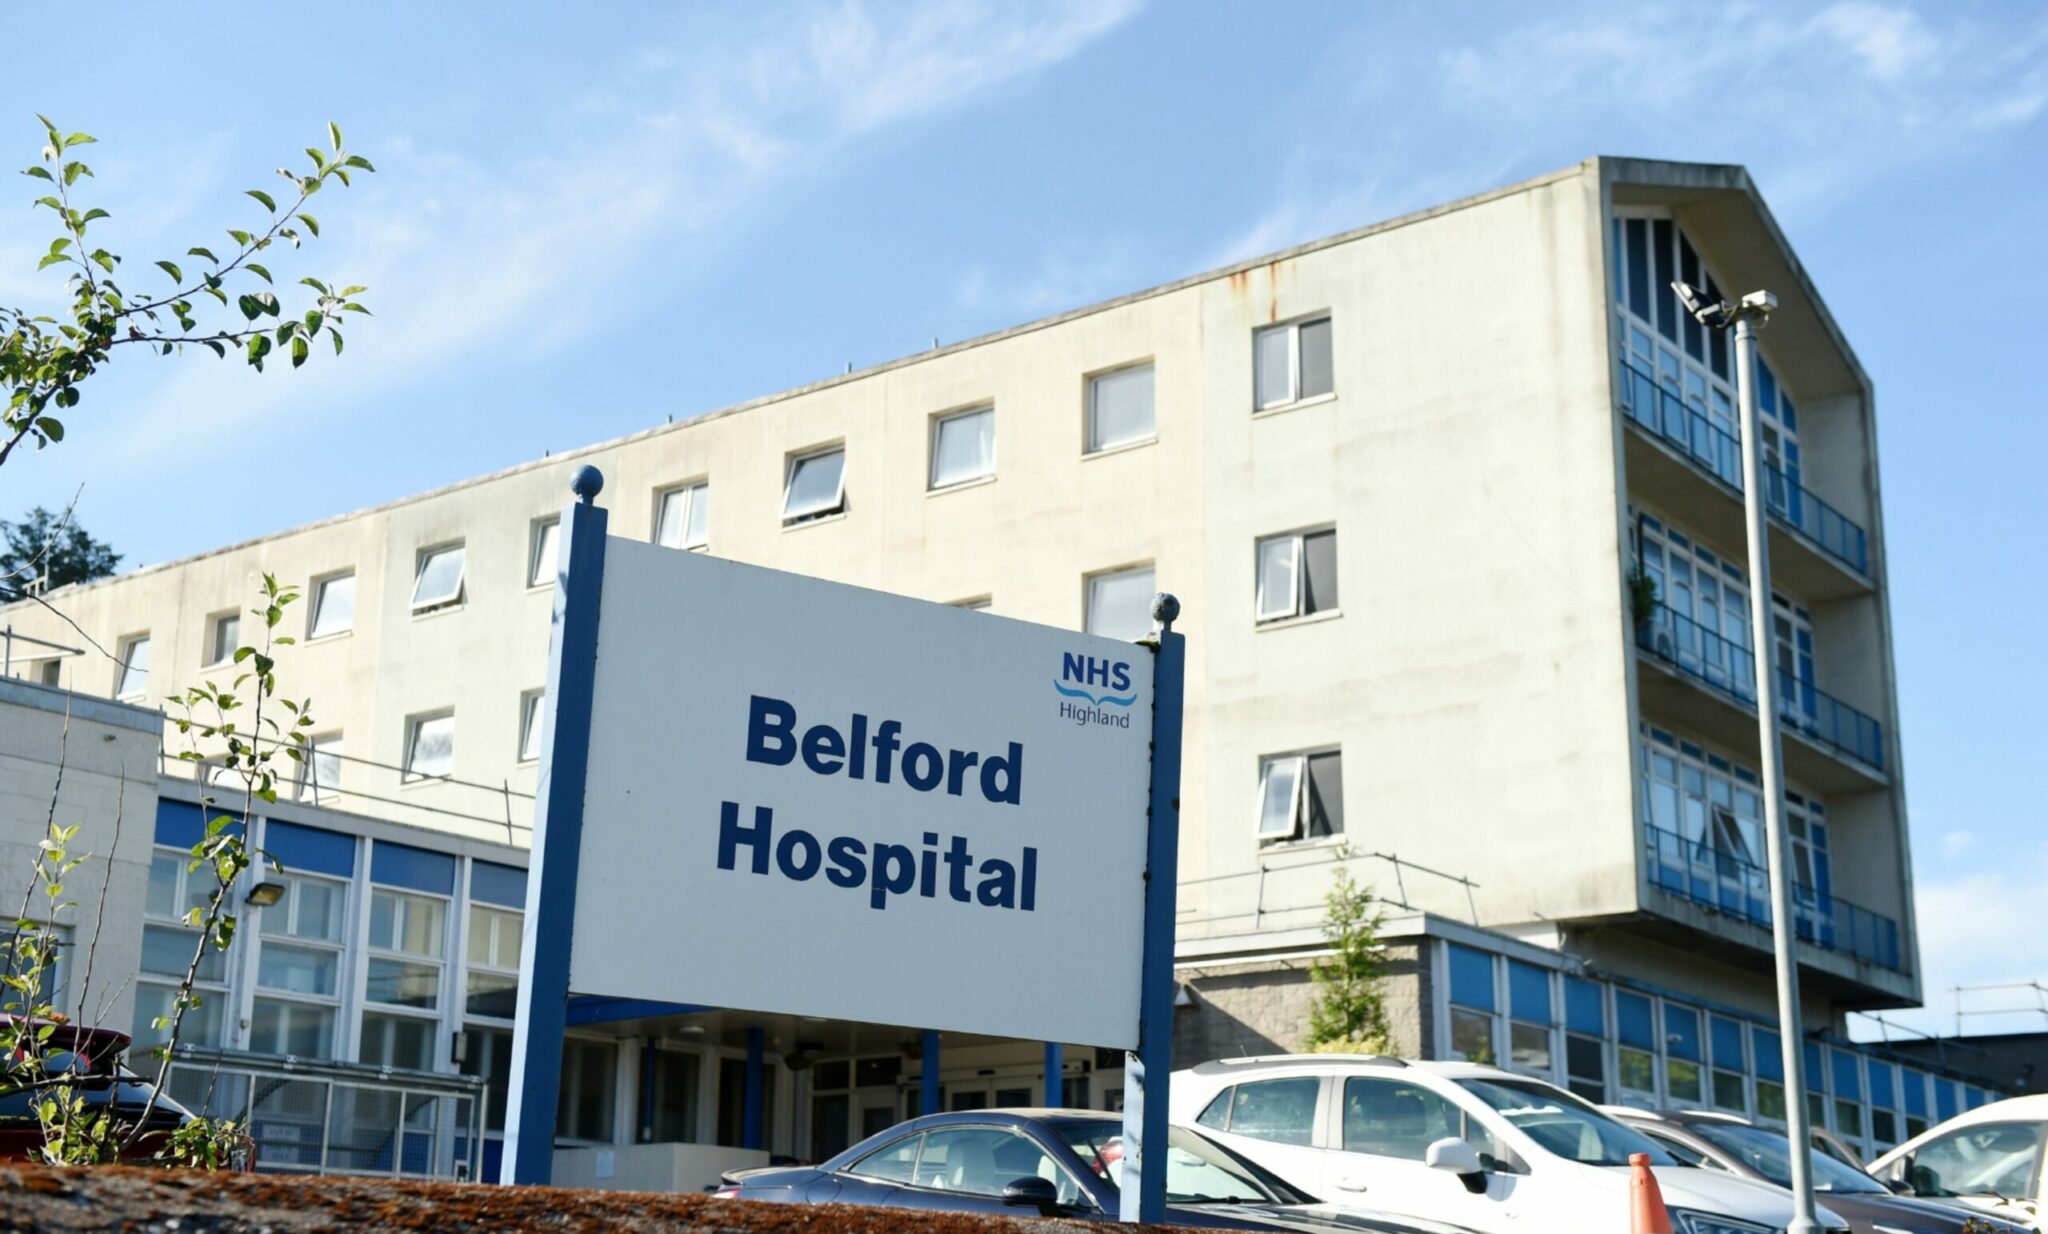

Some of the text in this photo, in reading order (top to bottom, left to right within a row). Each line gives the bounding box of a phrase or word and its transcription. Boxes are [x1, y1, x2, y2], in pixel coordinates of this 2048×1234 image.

[1063, 651, 1131, 692] NHS
[746, 695, 1023, 805] Belford
[1060, 701, 1130, 729] Highland
[717, 801, 1037, 911] Hospital
